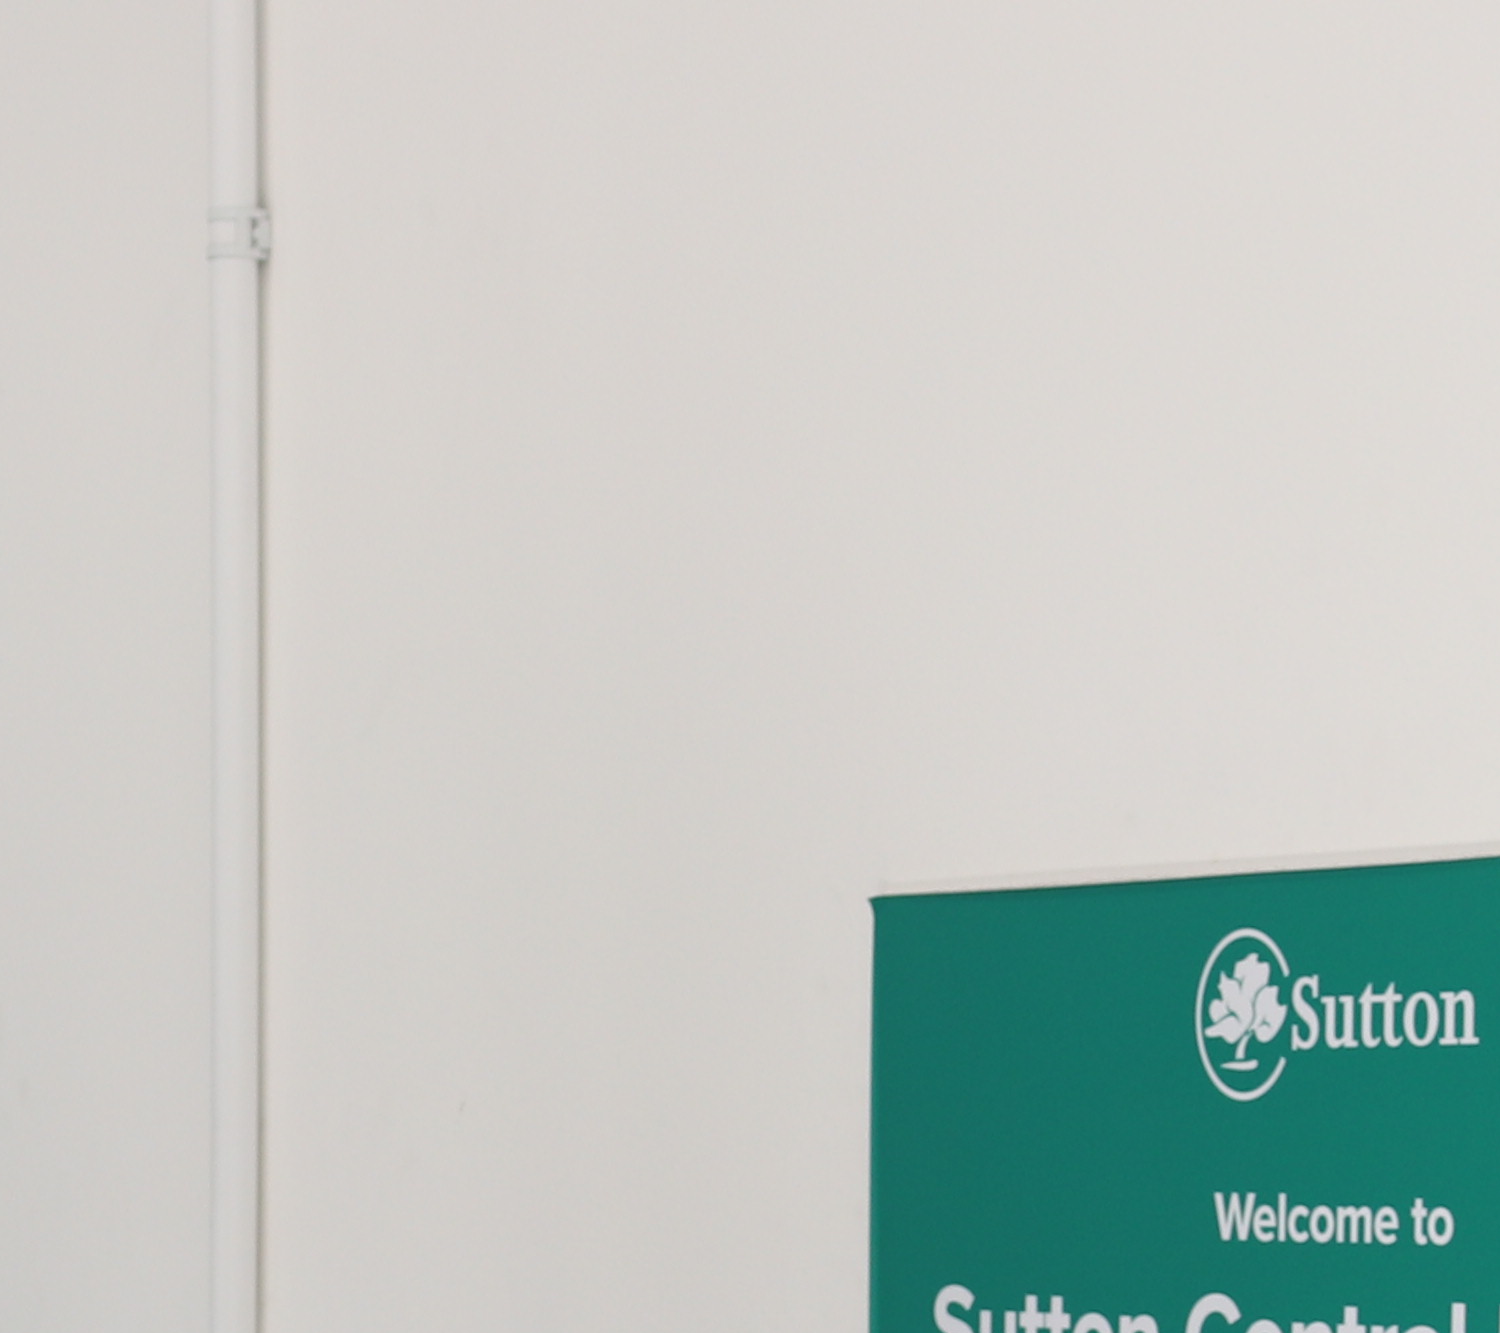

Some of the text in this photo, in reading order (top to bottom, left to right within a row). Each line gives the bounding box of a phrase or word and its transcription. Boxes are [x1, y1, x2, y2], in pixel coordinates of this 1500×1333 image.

[1292, 975, 1479, 1050] Sutton
[1215, 1193, 1453, 1245] Welcome to
